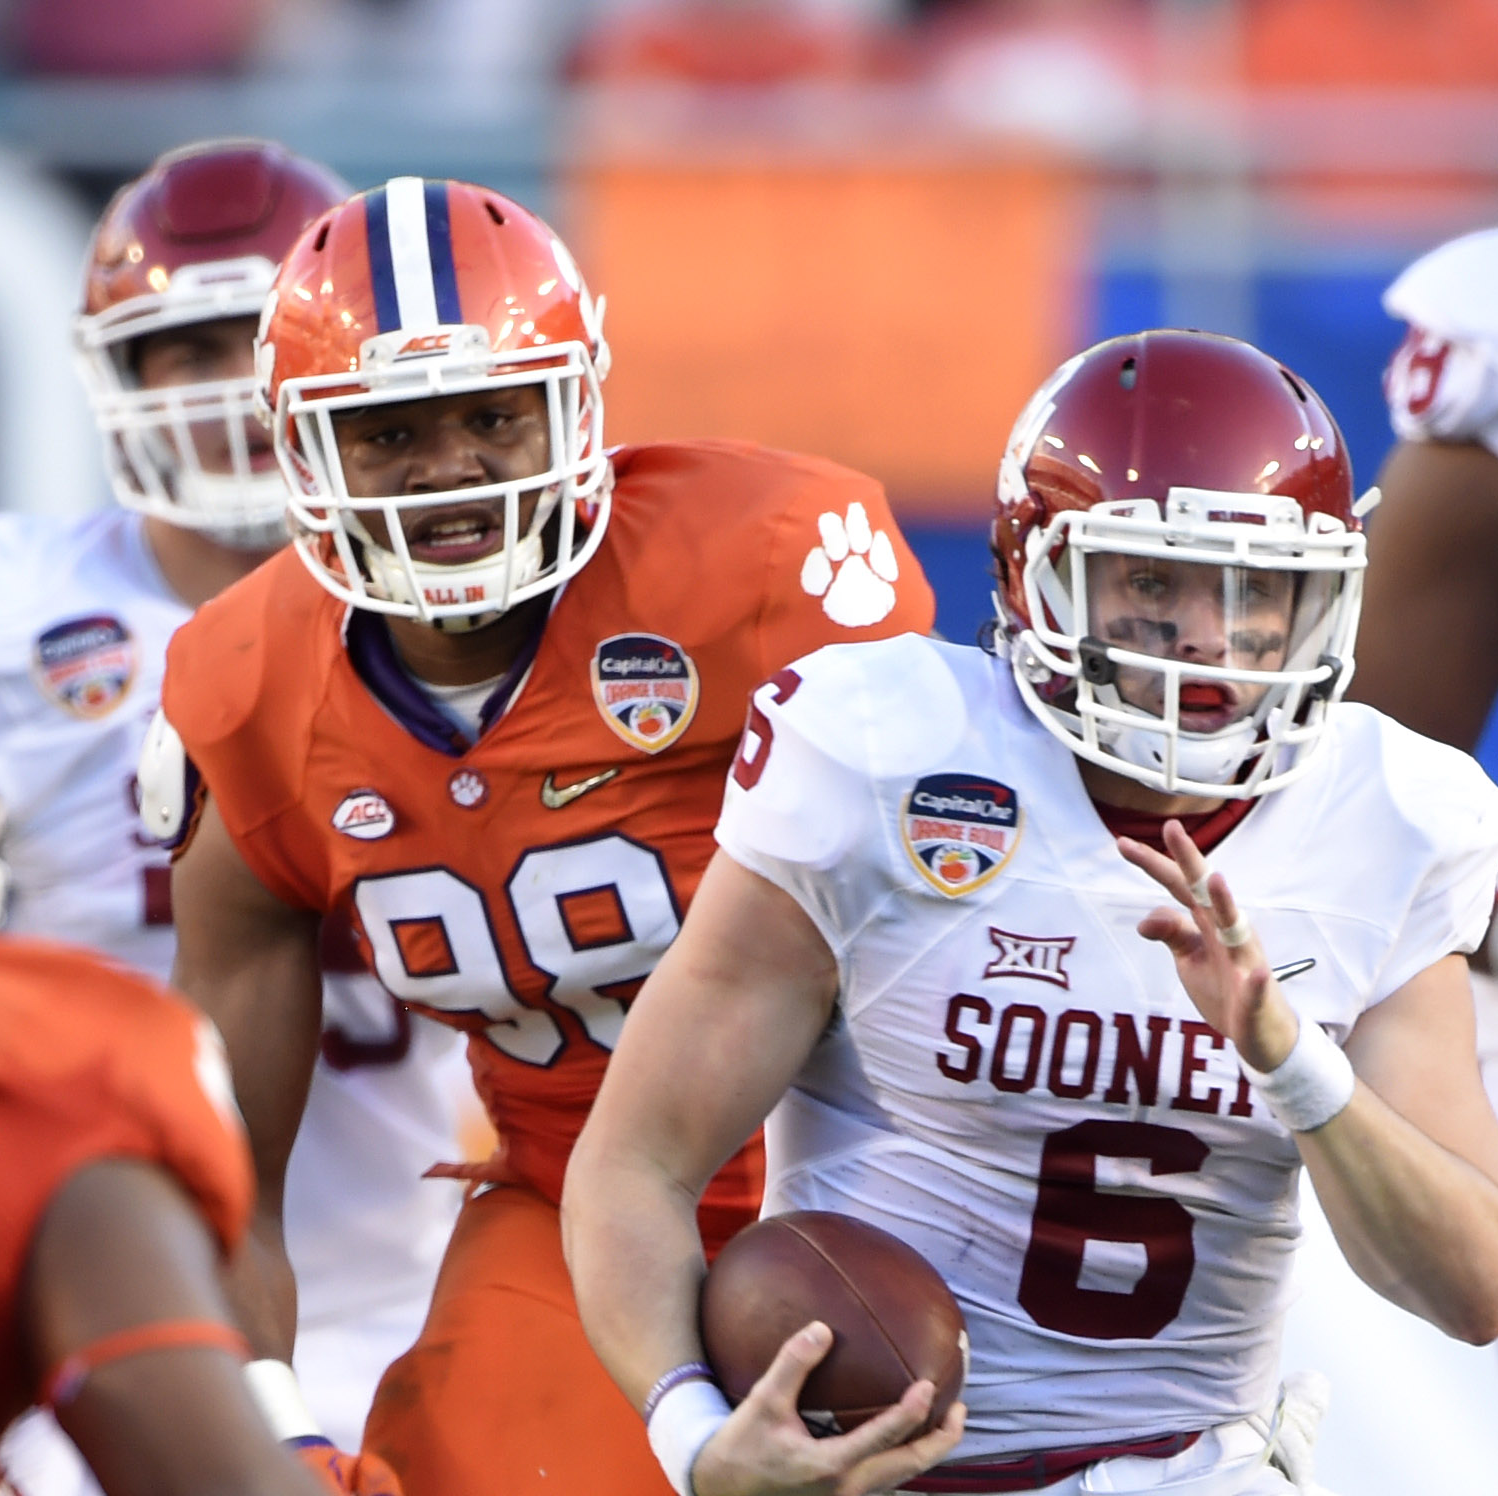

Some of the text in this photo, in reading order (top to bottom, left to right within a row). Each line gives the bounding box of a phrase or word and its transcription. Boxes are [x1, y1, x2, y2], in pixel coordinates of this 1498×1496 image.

[398, 334, 452, 355] ACC
[423, 585, 486, 605] ALL IN
[733, 668, 803, 792] 6
[354, 832, 685, 1068] 98
[936, 992, 1254, 1118] SOONE
[1017, 1119, 1211, 1340] 6
